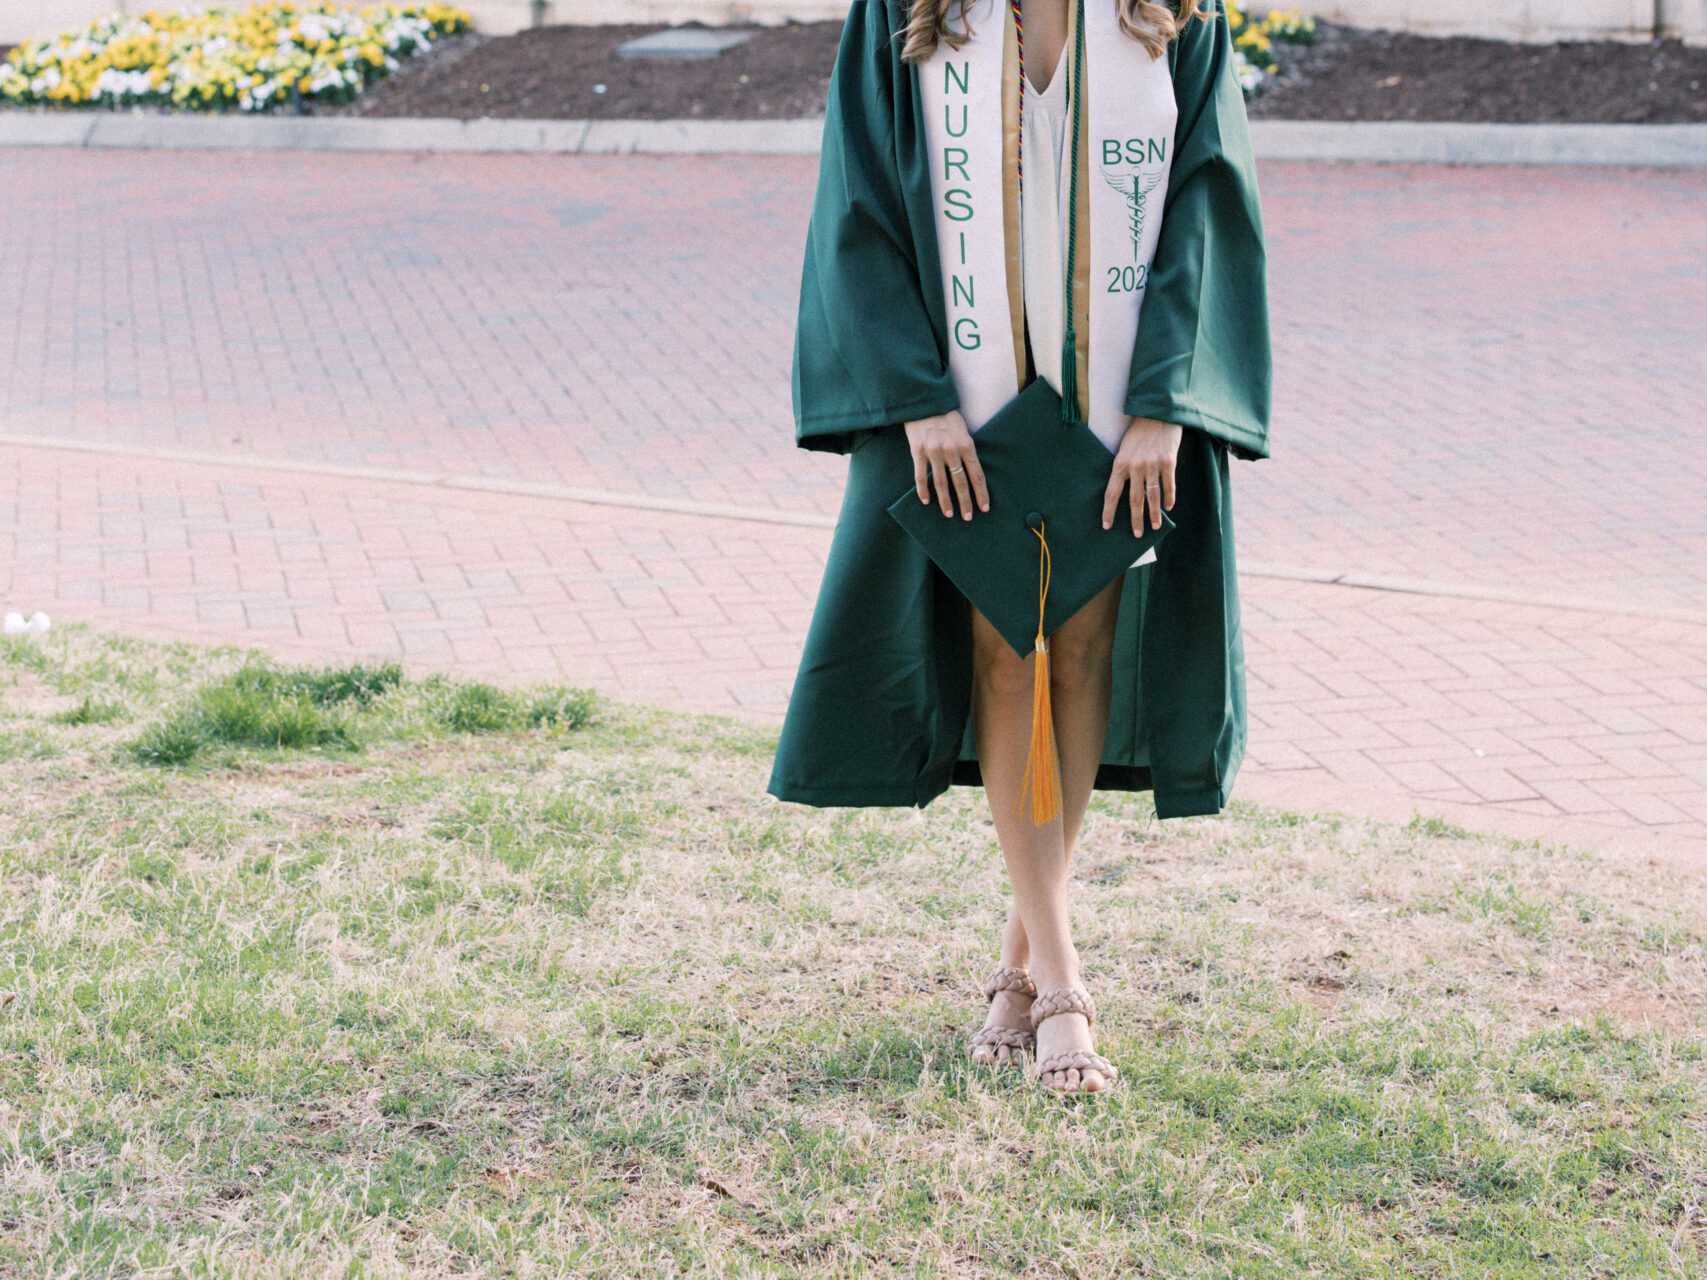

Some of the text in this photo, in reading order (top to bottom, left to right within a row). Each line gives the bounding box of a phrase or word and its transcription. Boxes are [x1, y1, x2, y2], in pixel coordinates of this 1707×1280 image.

[1102, 137, 1166, 166] BSN
[943, 60, 982, 351] NURSING
[1107, 263, 1149, 293] 202
